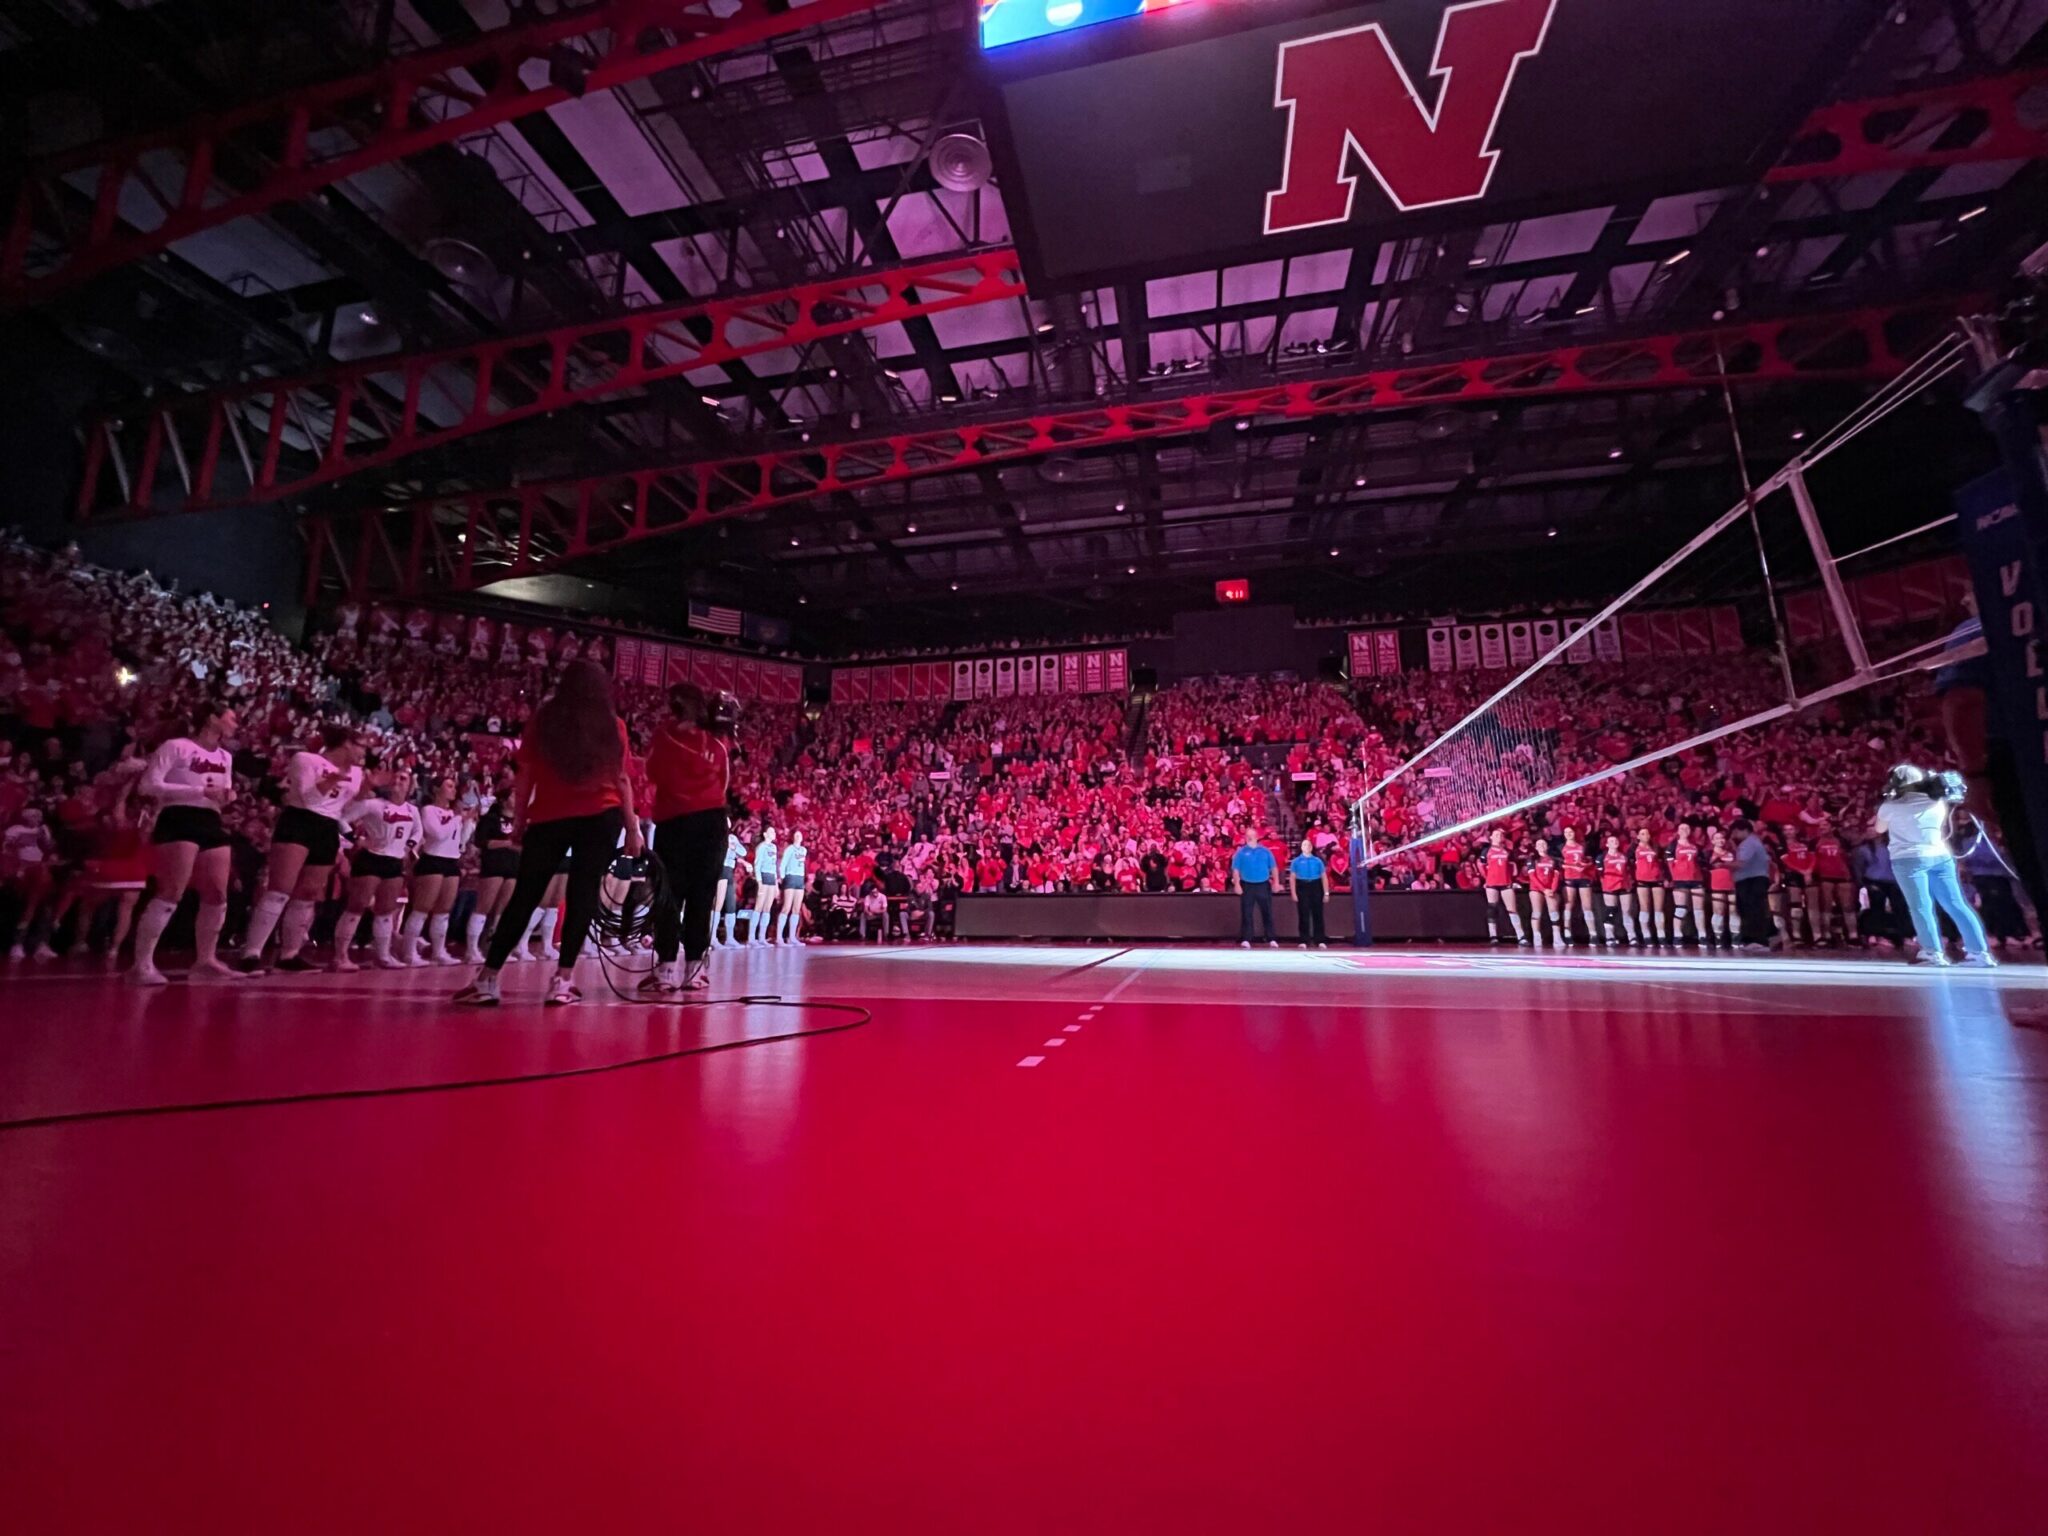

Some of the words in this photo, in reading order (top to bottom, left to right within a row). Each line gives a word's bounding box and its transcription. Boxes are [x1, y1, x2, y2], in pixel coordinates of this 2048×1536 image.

[1263, 0, 1558, 236] N
[1352, 635, 1369, 650] N
[1378, 633, 1395, 649] N
[1064, 655, 1078, 670] N
[1086, 654, 1100, 668] N
[1109, 652, 1123, 667] N
[395, 826, 404, 839] 6
